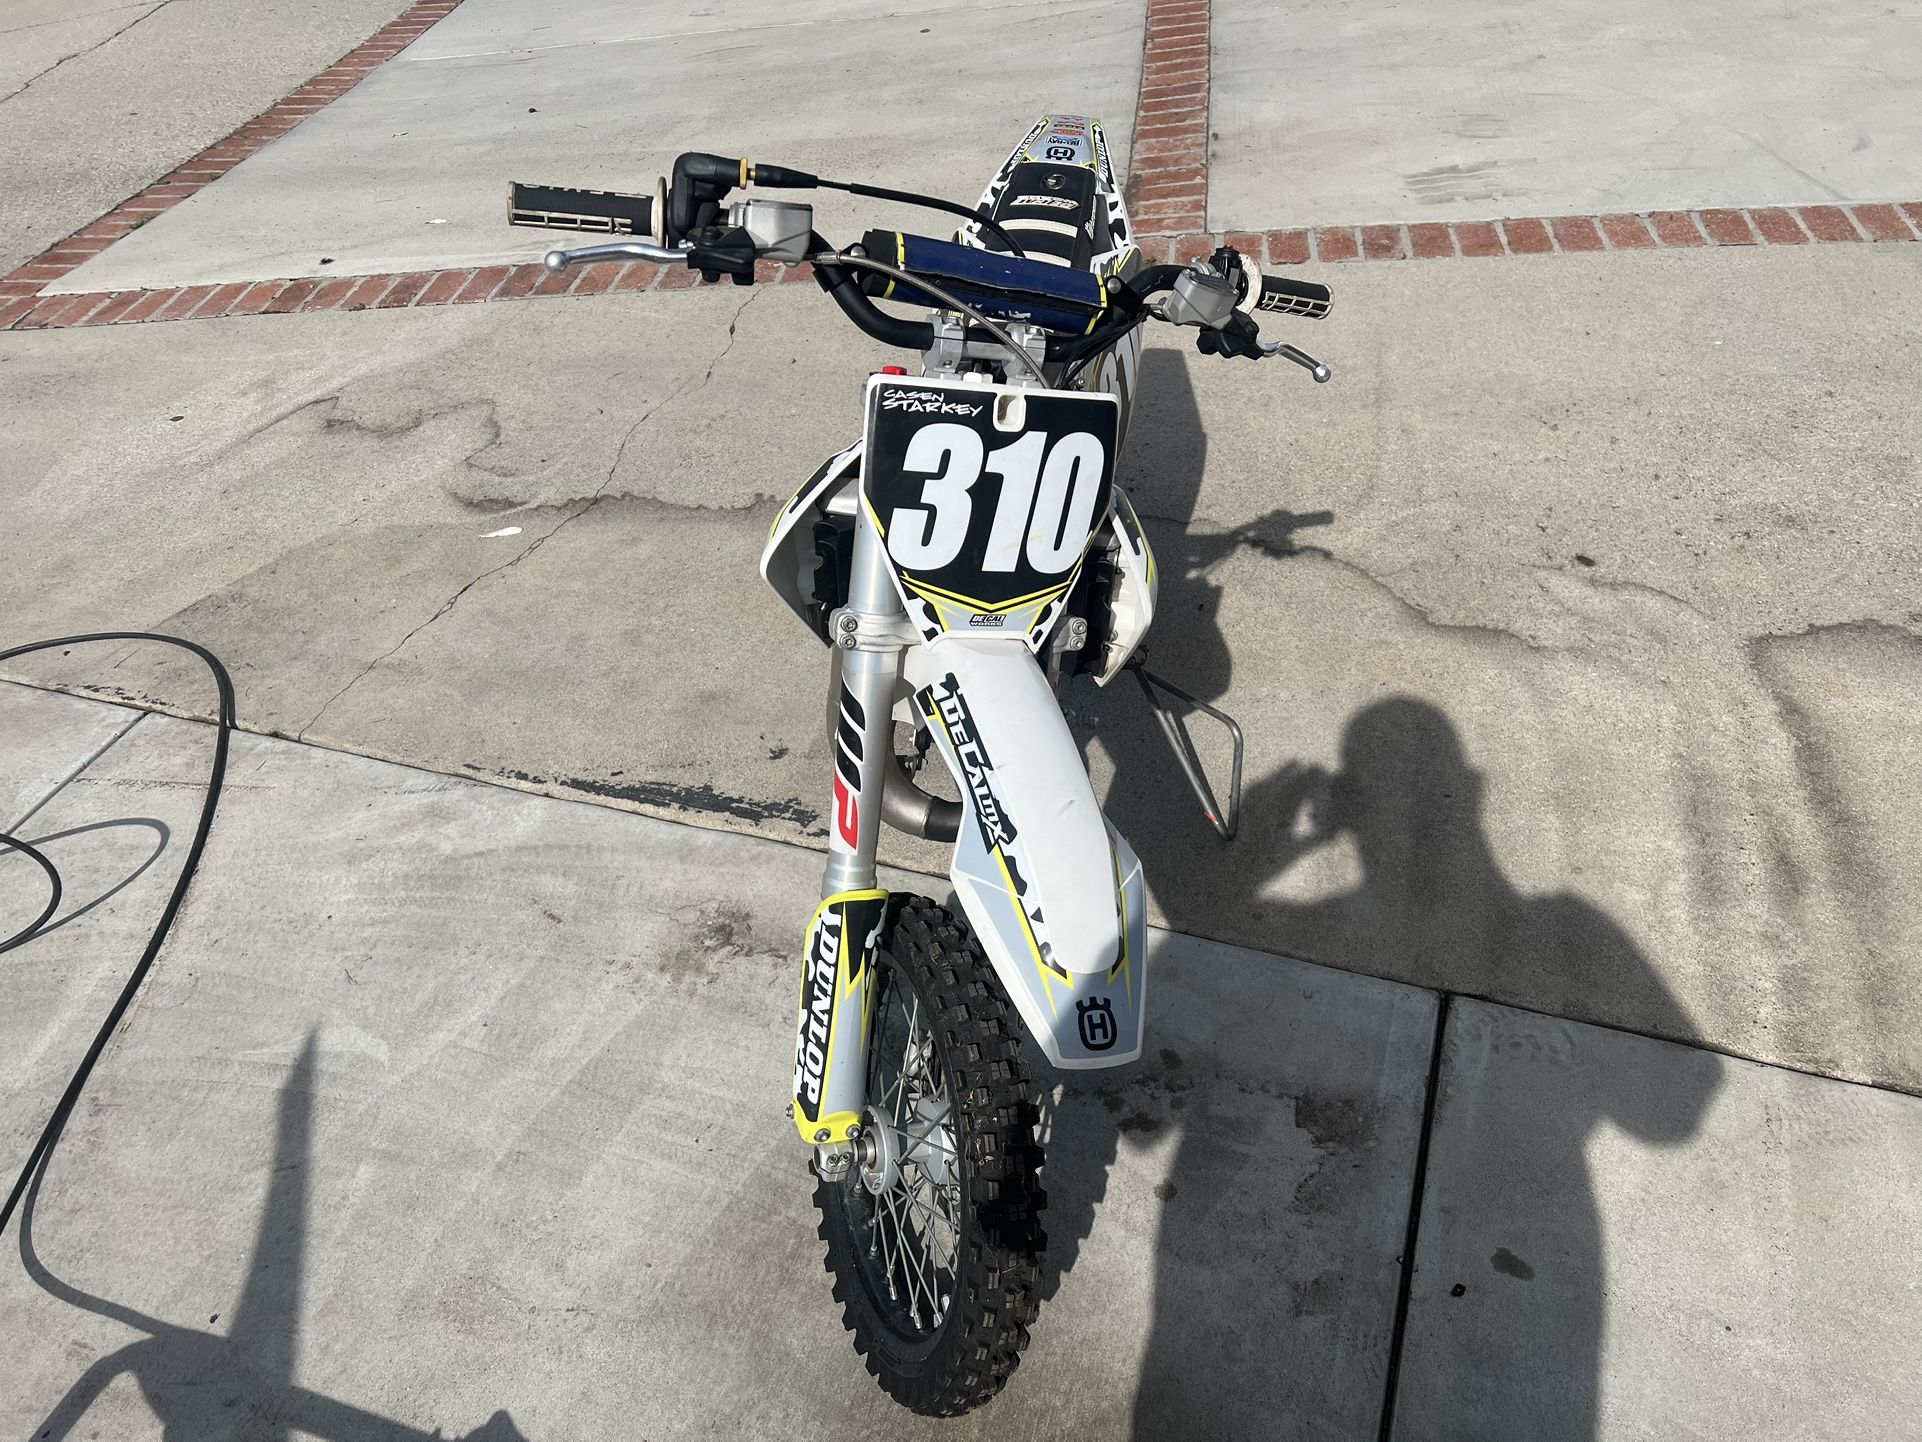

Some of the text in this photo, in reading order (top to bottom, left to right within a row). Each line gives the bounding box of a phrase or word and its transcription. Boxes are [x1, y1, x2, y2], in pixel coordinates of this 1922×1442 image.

[881, 399, 983, 416] STARKEY
[883, 389, 944, 402] CASEN
[887, 423, 1105, 574] 310
[803, 924, 838, 1105] DUNLOP
